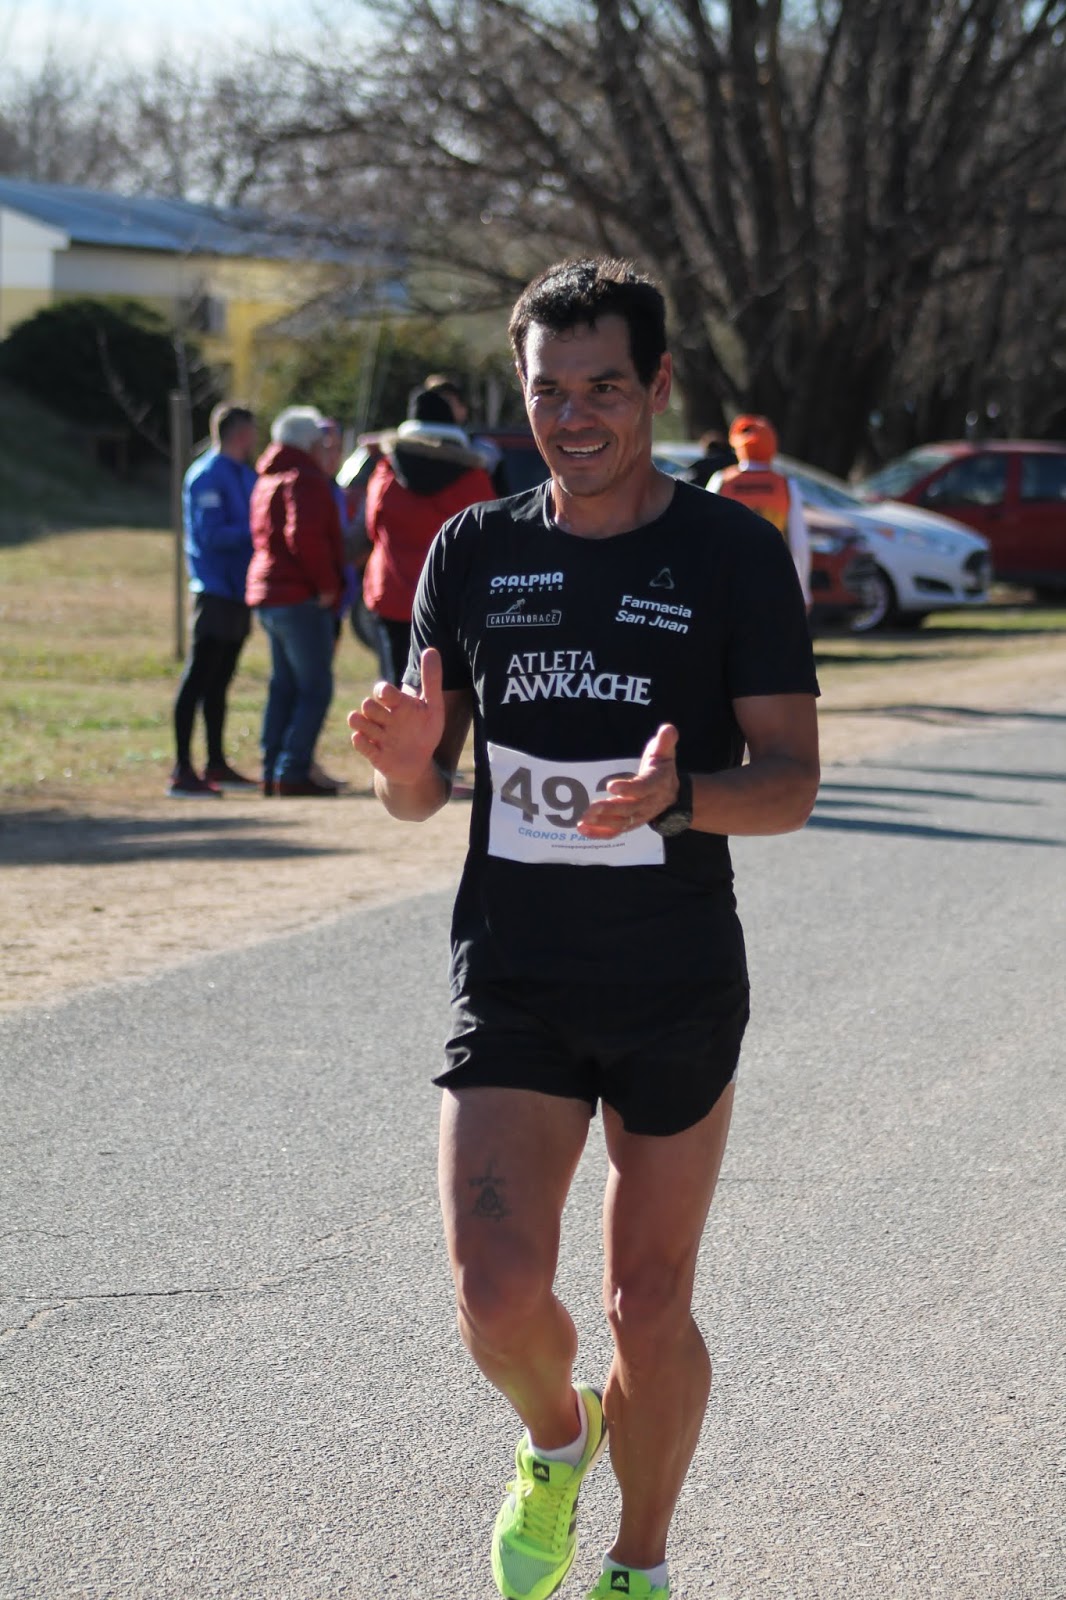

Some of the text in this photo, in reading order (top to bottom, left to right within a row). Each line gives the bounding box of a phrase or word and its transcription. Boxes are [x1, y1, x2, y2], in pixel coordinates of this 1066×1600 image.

[489, 585, 563, 595] DEPORTES
[621, 595, 693, 619] Farmacia
[615, 610, 689, 635] San Juan
[506, 651, 596, 675] ATLETA
[501, 672, 652, 706] AWKACHE
[518, 827, 567, 841] CRONOS
